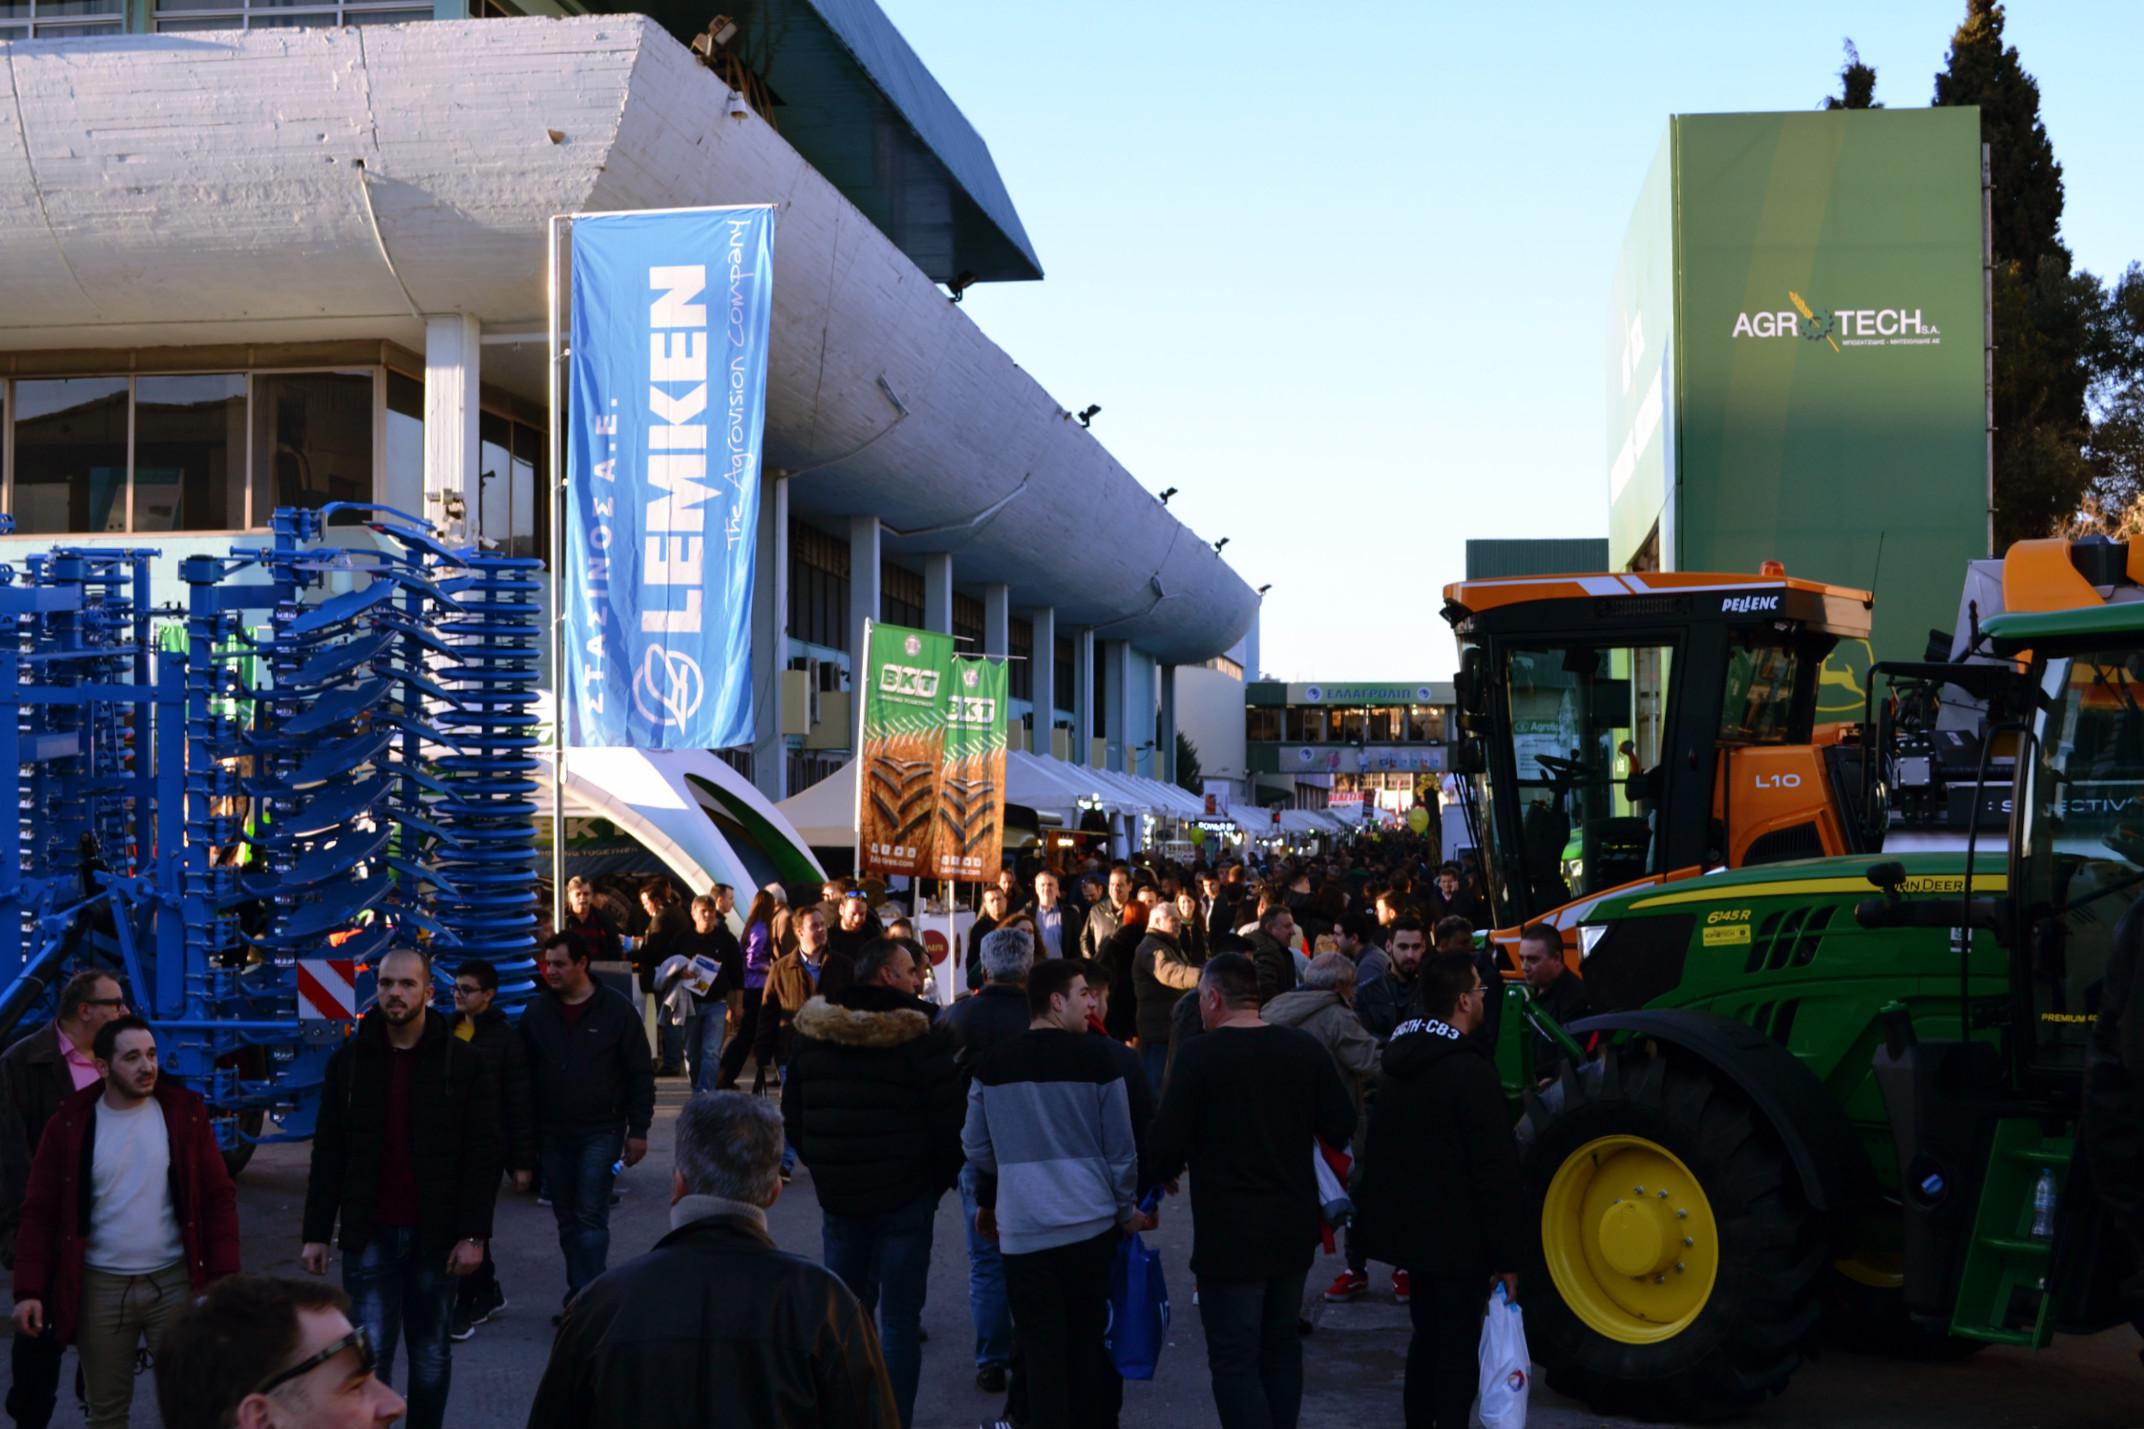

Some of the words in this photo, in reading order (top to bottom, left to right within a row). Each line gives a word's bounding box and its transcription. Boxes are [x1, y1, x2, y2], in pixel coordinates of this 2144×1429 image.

[726, 217, 757, 349] Company
[722, 355, 755, 491] Agrovision
[640, 264, 722, 634] LEMKEN
[723, 503, 745, 551] The
[1722, 595, 1779, 613] PELLENC
[881, 666, 939, 696] BKT
[948, 697, 994, 721] BKT
[1755, 774, 1801, 788] L10
[1922, 878, 1965, 891] DEER
